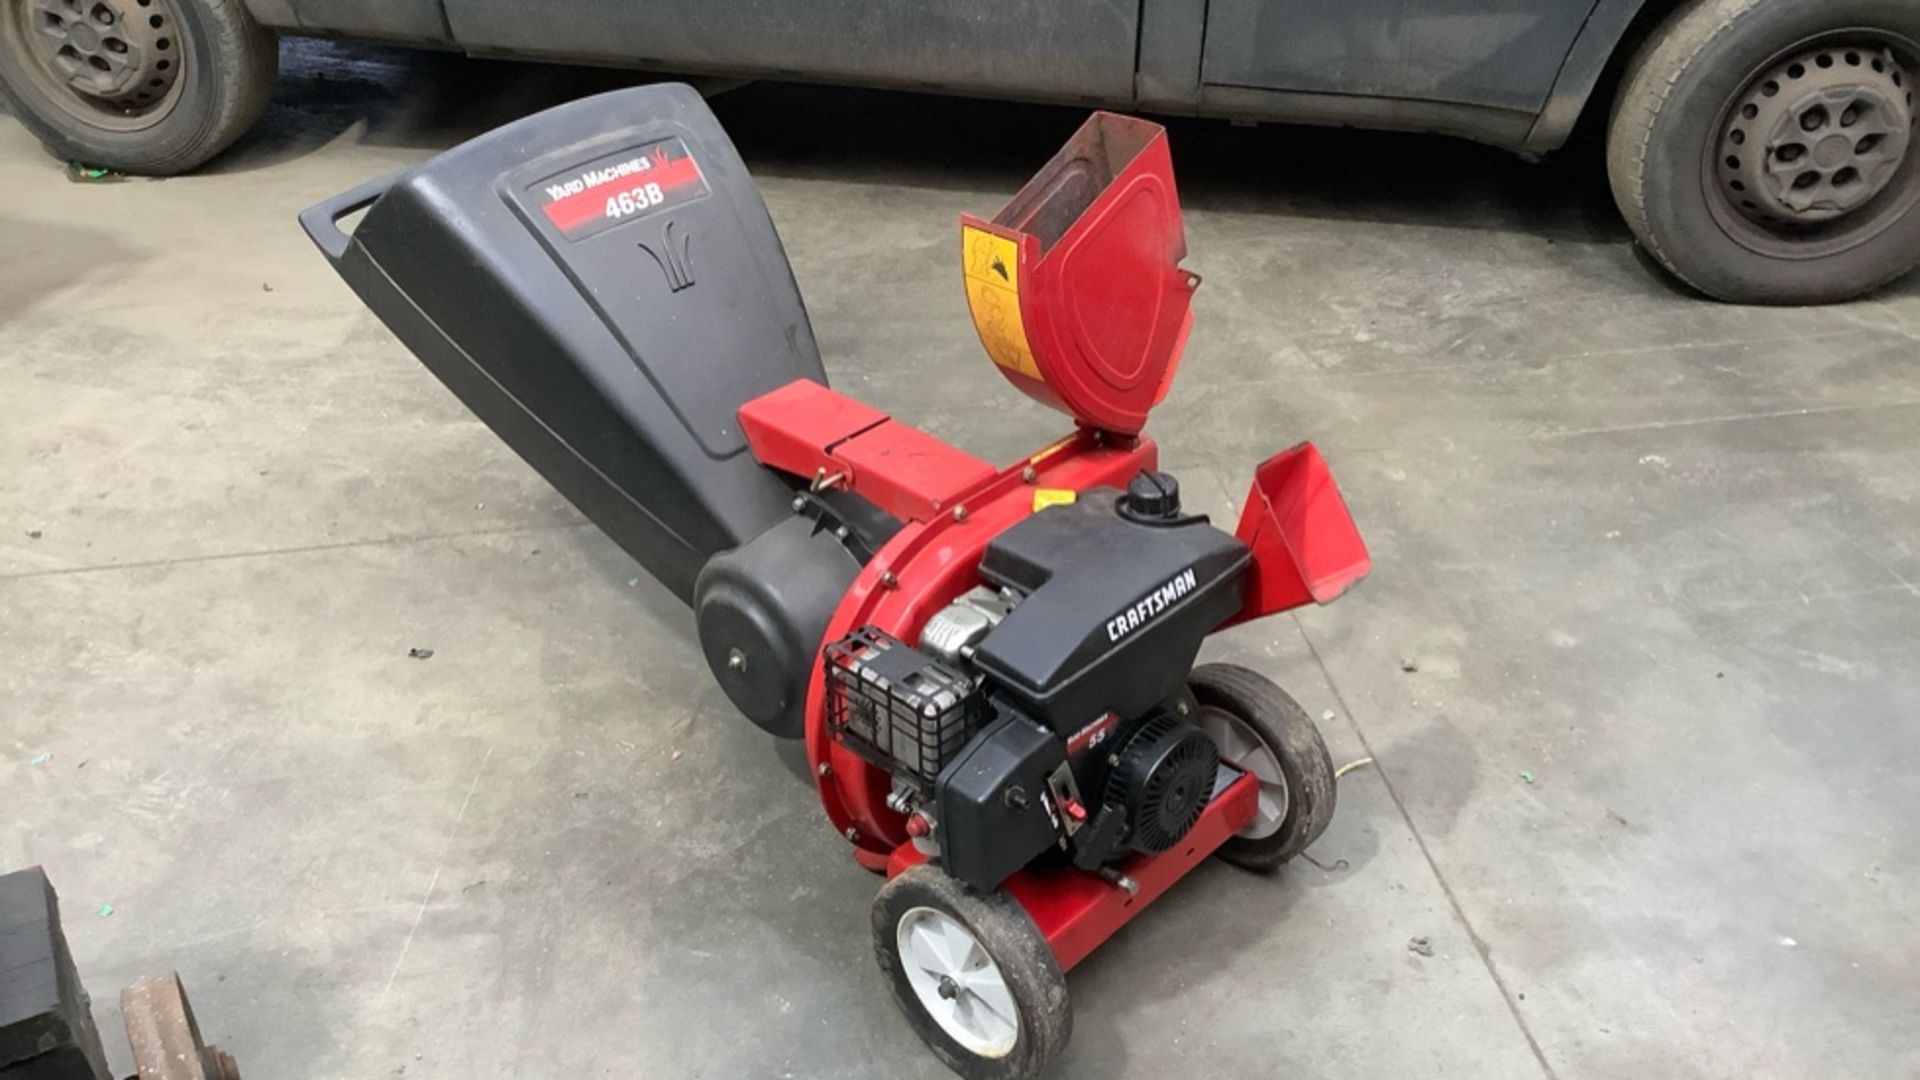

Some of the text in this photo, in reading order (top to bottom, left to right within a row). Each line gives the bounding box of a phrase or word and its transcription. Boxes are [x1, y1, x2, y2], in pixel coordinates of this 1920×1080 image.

[582, 156, 651, 189] MACHINES
[605, 182, 664, 218] 463B
[1107, 568, 1196, 642] CRAFTSMAN
